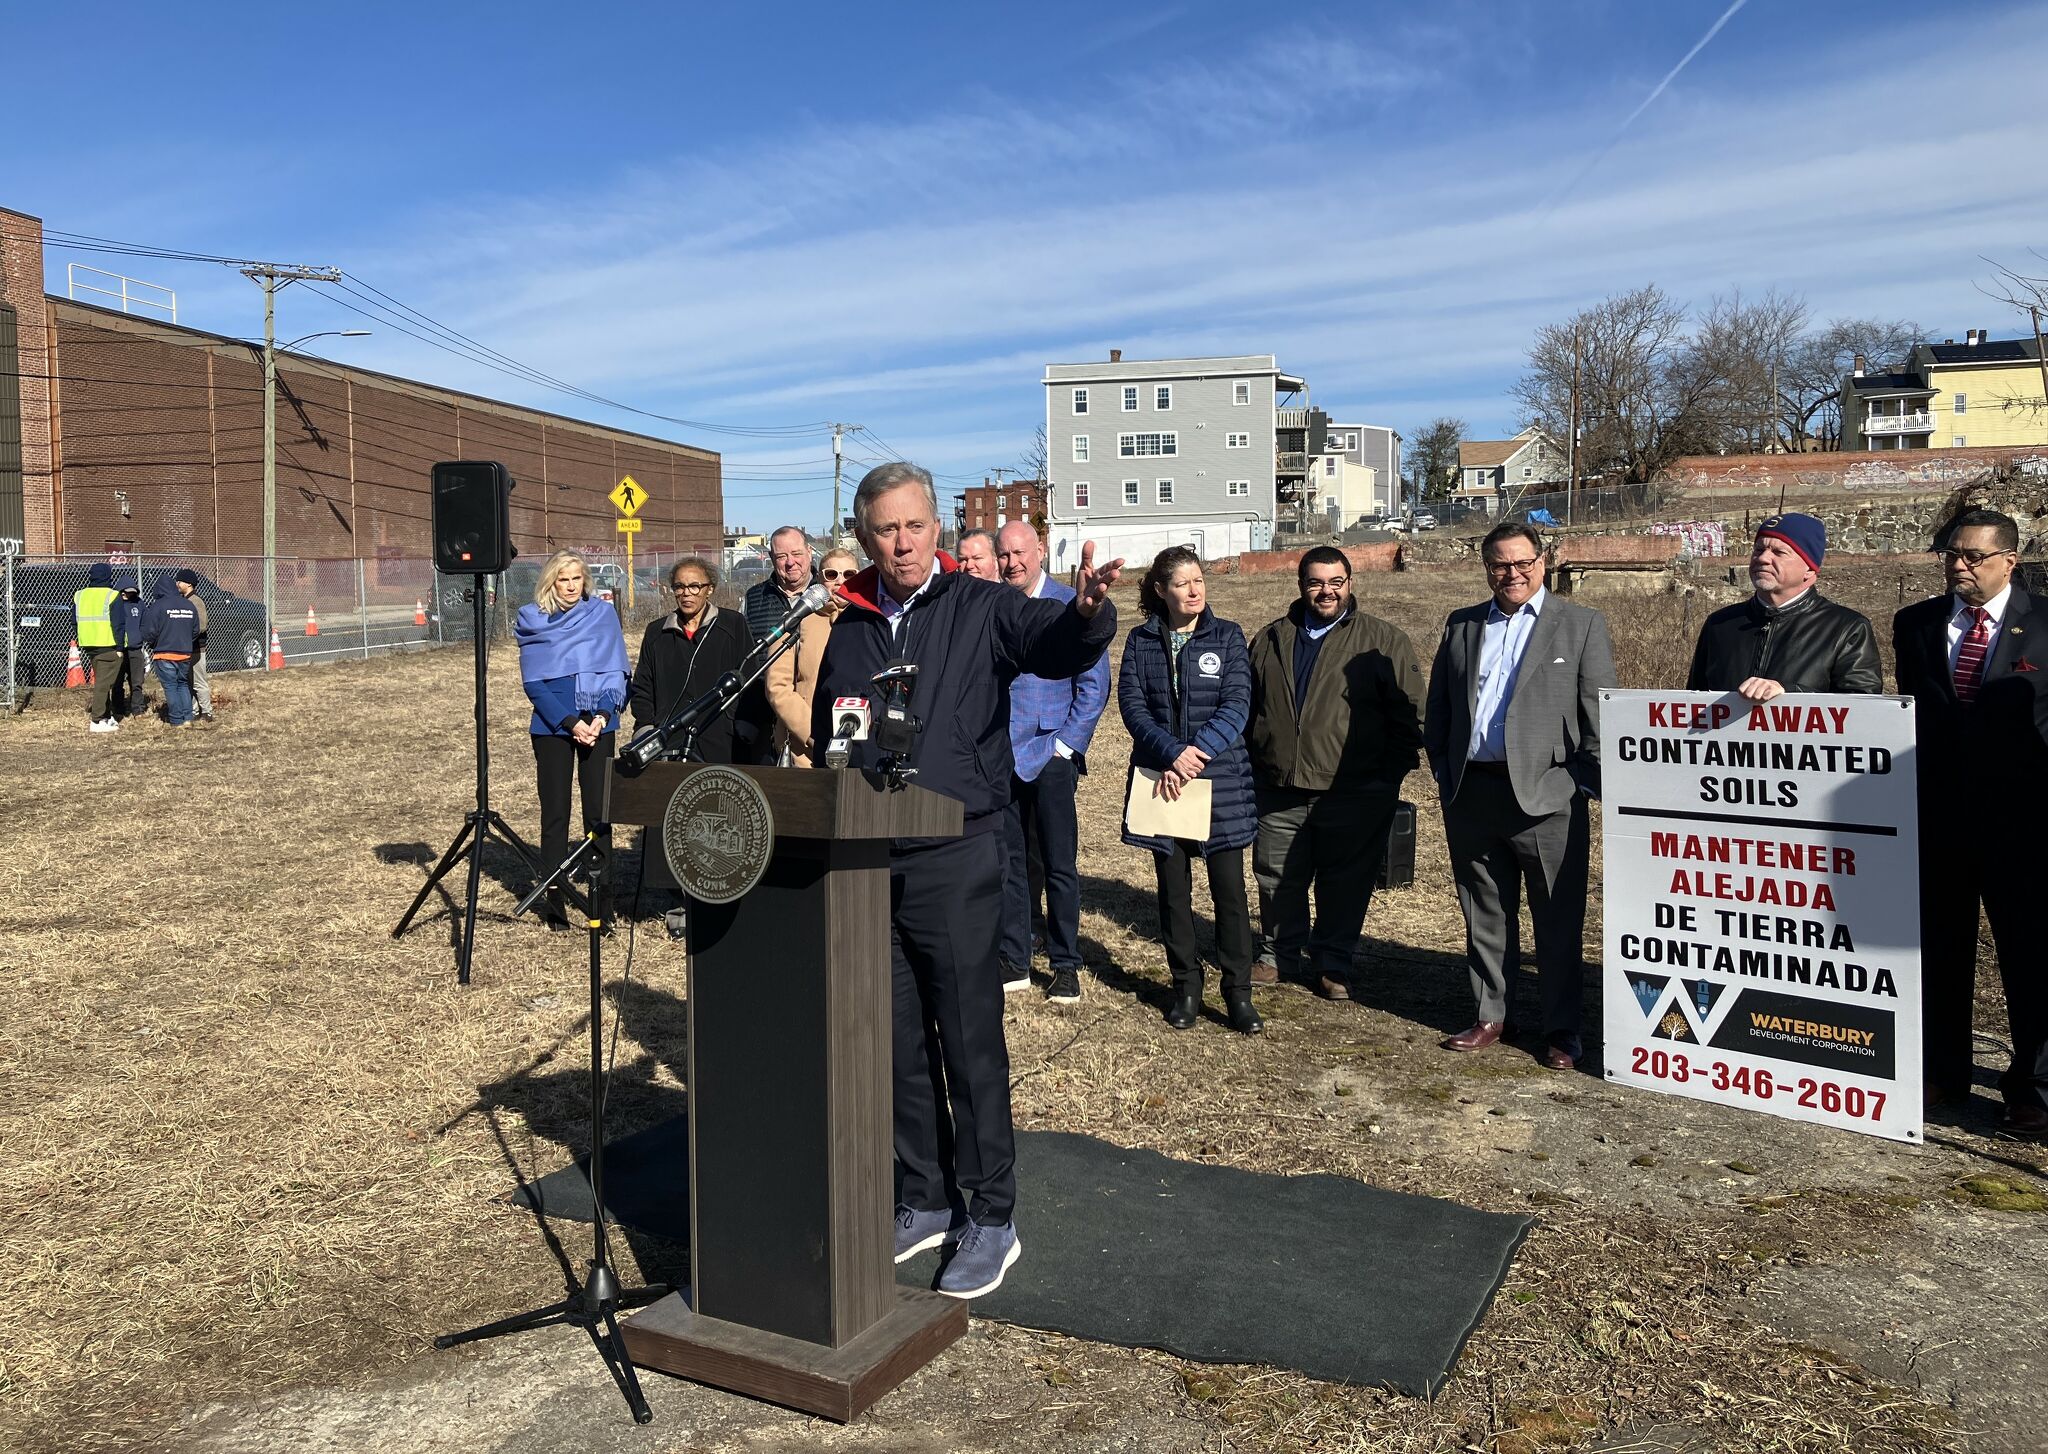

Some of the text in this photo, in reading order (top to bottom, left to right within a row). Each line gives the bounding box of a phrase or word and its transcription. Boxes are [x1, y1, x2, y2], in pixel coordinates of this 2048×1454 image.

[840, 697, 863, 708] 8
[1649, 702, 1850, 734] KEEP AWAY
[1618, 736, 1892, 775] CONTAMINATED
[682, 784, 702, 806] THE
[700, 778, 726, 791] CITY
[724, 780, 740, 794] OF
[1700, 776, 1799, 808] SOILS
[674, 803, 687, 823] OF
[739, 786, 763, 866] WATERBURY
[672, 825, 685, 857] SEAL
[1650, 831, 1856, 876] MANTENER
[1669, 869, 1837, 912] ALEJADA
[1654, 902, 1855, 953] DE TIERRA
[1620, 934, 1899, 998] CONTAMINADA
[1749, 1028, 1876, 1057] DEVELOPMENT CORPORATION
[1750, 1012, 1875, 1047] WATERBURY
[1631, 1046, 1887, 1122] 203-346-2607
